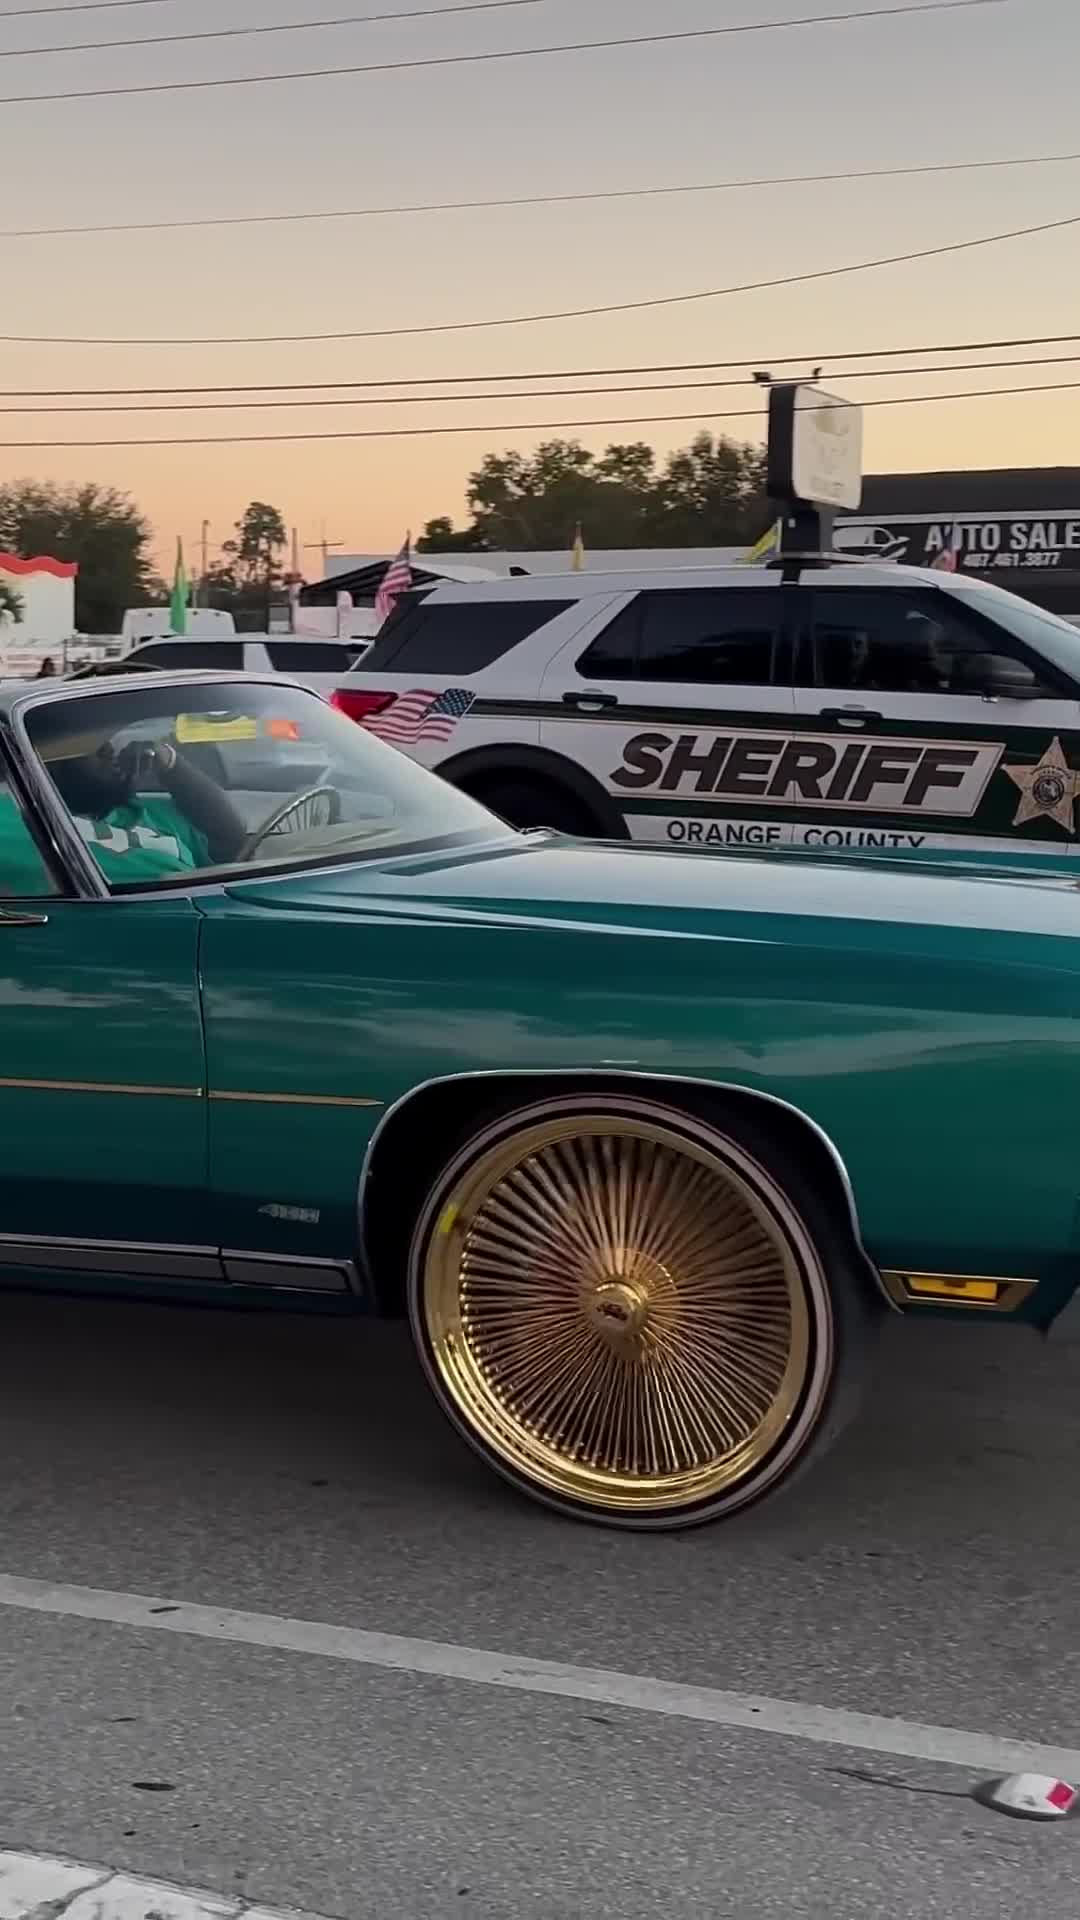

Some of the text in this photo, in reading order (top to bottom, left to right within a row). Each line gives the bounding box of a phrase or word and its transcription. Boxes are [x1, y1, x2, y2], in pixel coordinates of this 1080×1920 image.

[1010, 521, 1080, 550] SALE
[609, 732, 979, 805] SHERIFF
[667, 820, 925, 848] ORANGE COUNTY
